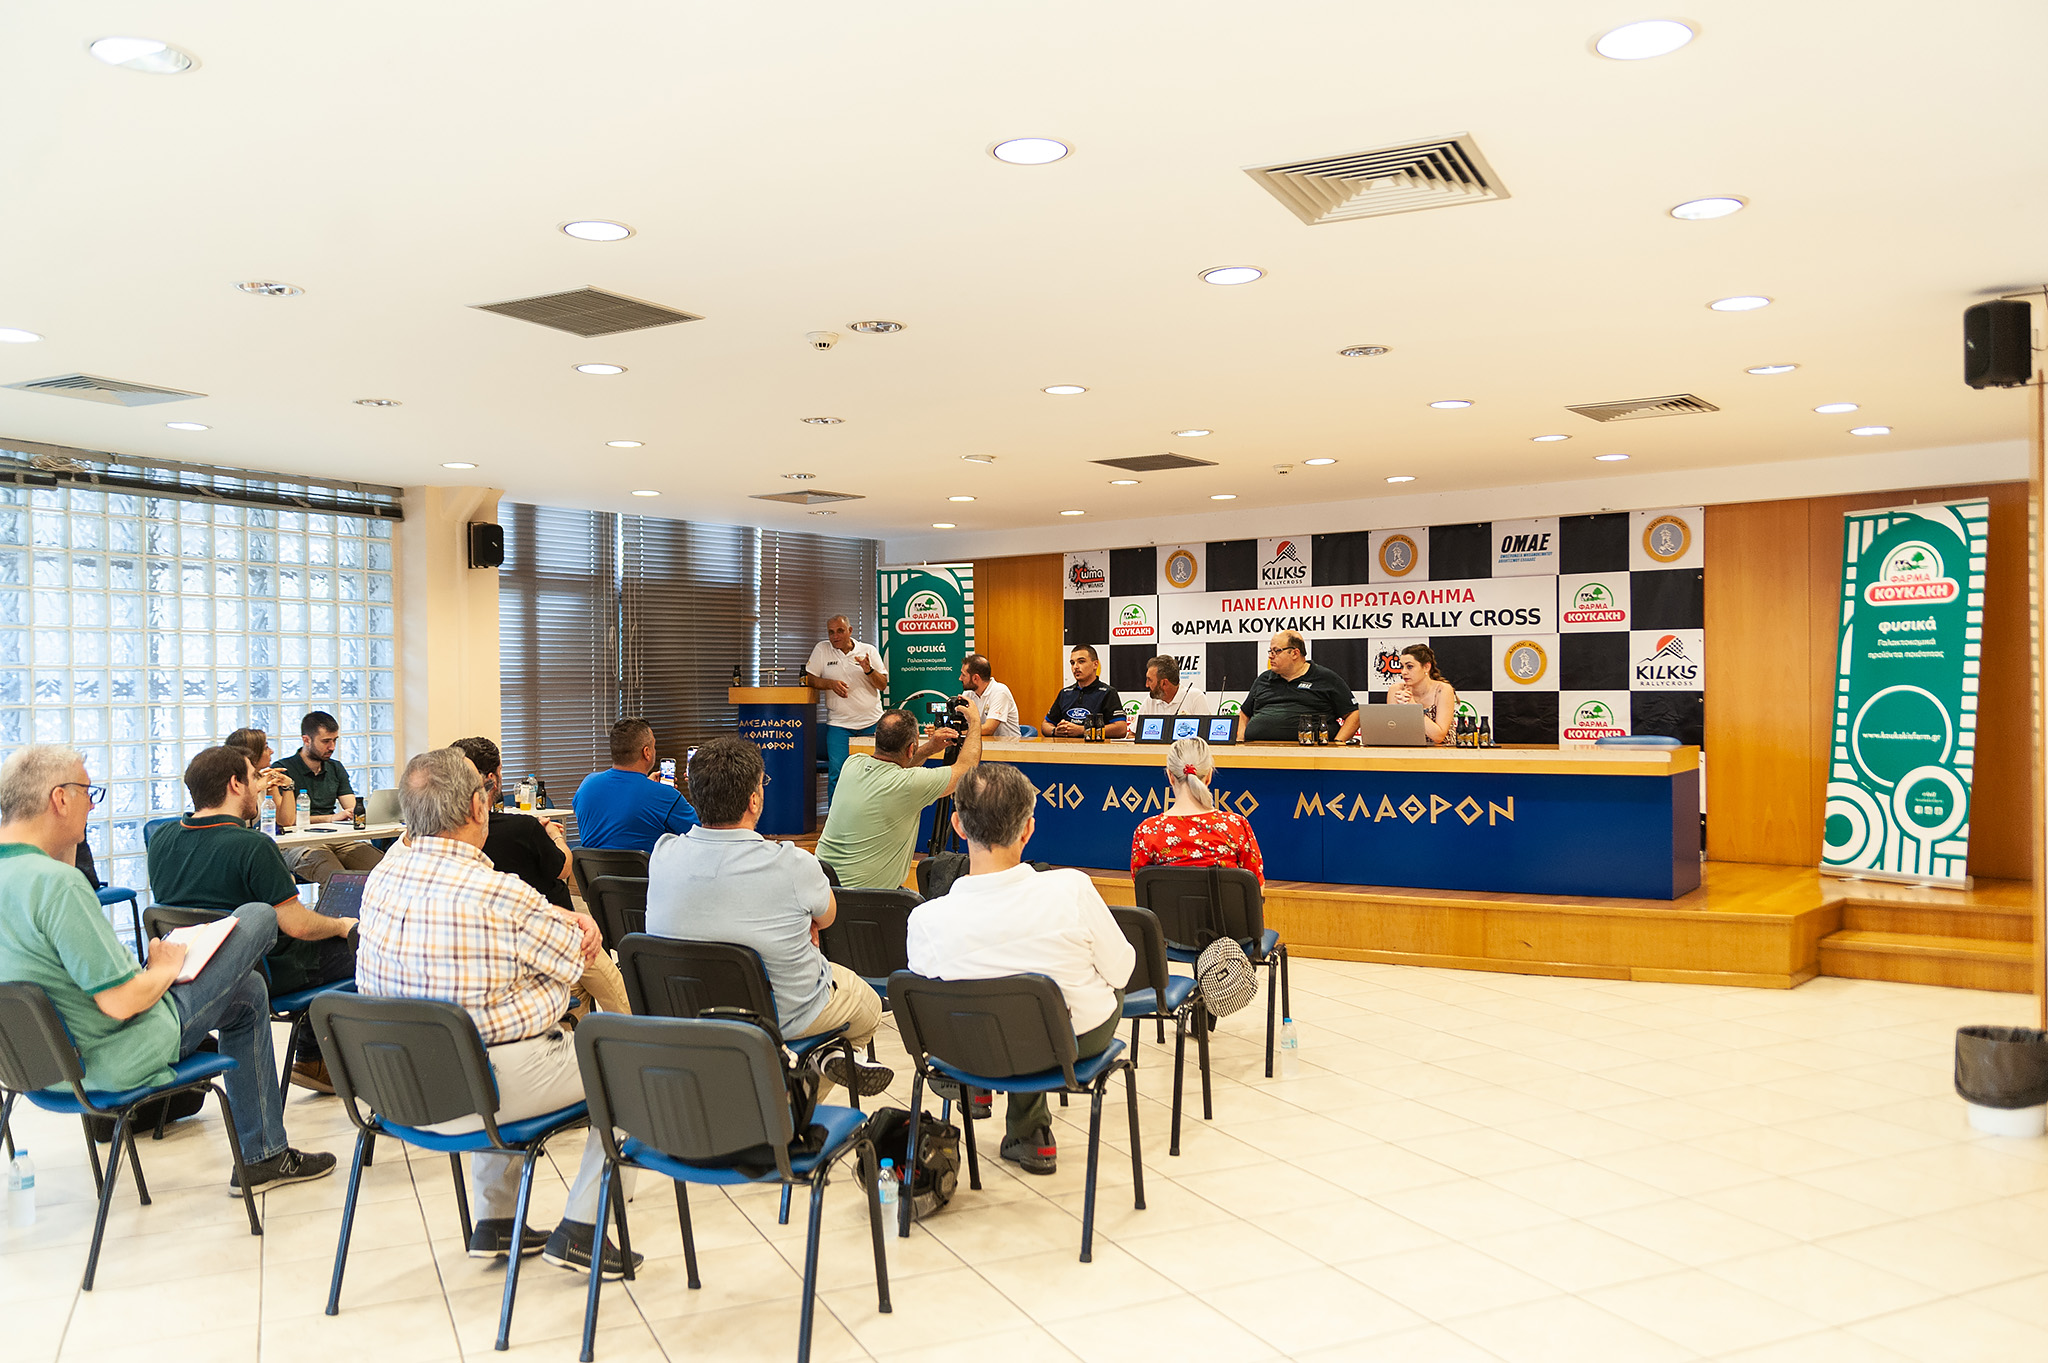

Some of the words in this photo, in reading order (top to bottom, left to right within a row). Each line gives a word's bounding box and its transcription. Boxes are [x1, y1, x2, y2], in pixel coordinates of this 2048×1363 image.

[1262, 566, 1307, 580] KILKIS
[1890, 574, 1930, 583] ΦΑΡΜΑ
[1874, 584, 1948, 600] ΚΟΥΚΑΚΗ
[1222, 594, 1334, 612] ΠΑΝΕΛΛΗΝΙΟ
[1340, 588, 1475, 608] ΠΡΩΤΑΘΛΗΜΑ
[1171, 619, 1233, 636] ΦΑΡΜΑ
[1239, 616, 1325, 634] ΚΟΥΚΑΚΗ
[1332, 612, 1394, 630] KILKIS
[1402, 611, 1463, 628] RALLY
[1469, 607, 1541, 626] CROSS
[1567, 611, 1621, 621] ΚΟΥΚΑΚΗ
[902, 622, 952, 630] ΚΟΥΚΑΚΗ
[1878, 616, 1937, 634] φυσικά
[907, 642, 946, 654] φυσικά
[1174, 655, 1200, 670] ΜΑΕ
[1636, 665, 1698, 680] KILKIS
[739, 719, 803, 728] ΑΛΕΞΑΝΔΡΕΙΟ
[1567, 730, 1621, 739] ΚΟΥΚΑΚΗ
[1102, 785, 1260, 817] ΑΘΛΗΚΟ
[1293, 791, 1515, 826] ΜΕΛΑΘΡΟΝ
